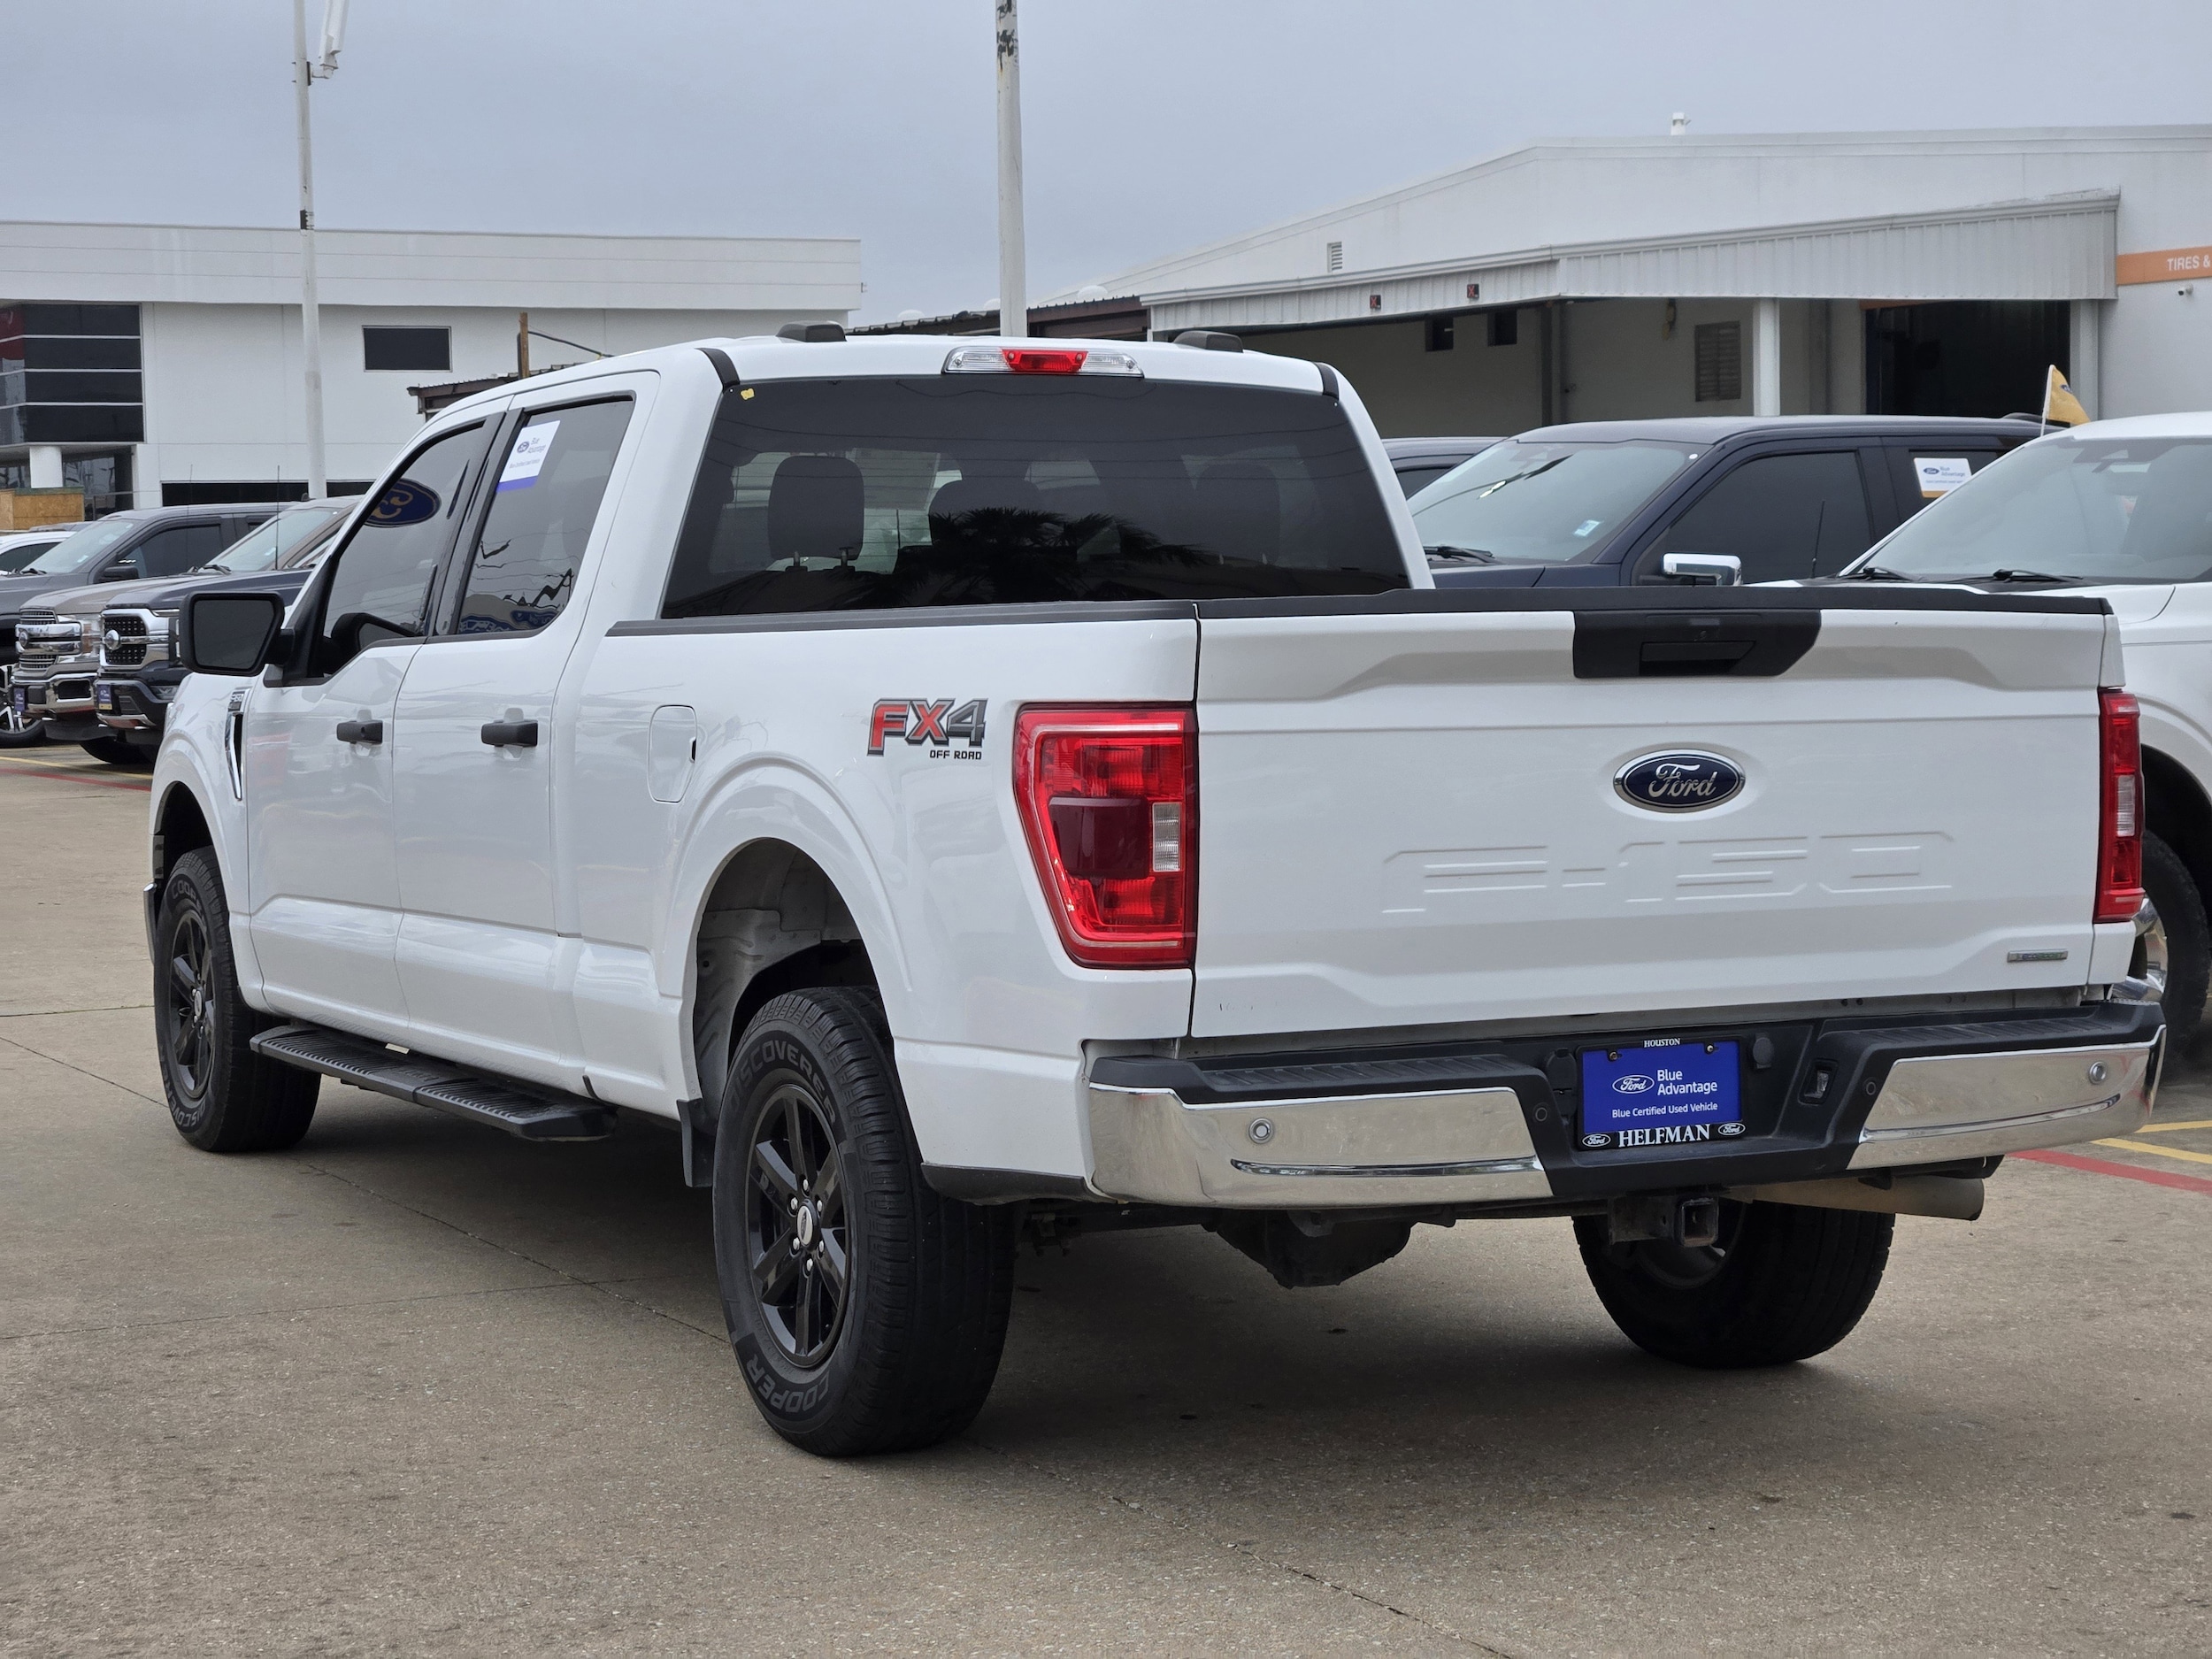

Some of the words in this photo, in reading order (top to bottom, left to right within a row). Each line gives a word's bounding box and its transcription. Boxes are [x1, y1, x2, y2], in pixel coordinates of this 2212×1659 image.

[2167, 255, 2200, 271] TIRES
[2203, 254, 2210, 268] &
[866, 697, 988, 757] FX4
[929, 749, 950, 759] OFF
[954, 750, 982, 760] ROAD
[1648, 763, 1717, 797] Ford
[1644, 1038, 1680, 1048] HOUSTON
[729, 1040, 836, 1125] DISCOVERER
[1657, 1069, 1683, 1081] Blue
[1620, 1077, 1647, 1092] Ford
[1657, 1080, 1718, 1095] Advantage
[1612, 1109, 1631, 1118] Blue
[1632, 1106, 1666, 1117] Certified
[1668, 1103, 1688, 1114] Used
[1690, 1102, 1718, 1112] Vehicle
[1617, 1124, 1710, 1148] HELFMAN
[746, 1353, 830, 1413] COOPER
